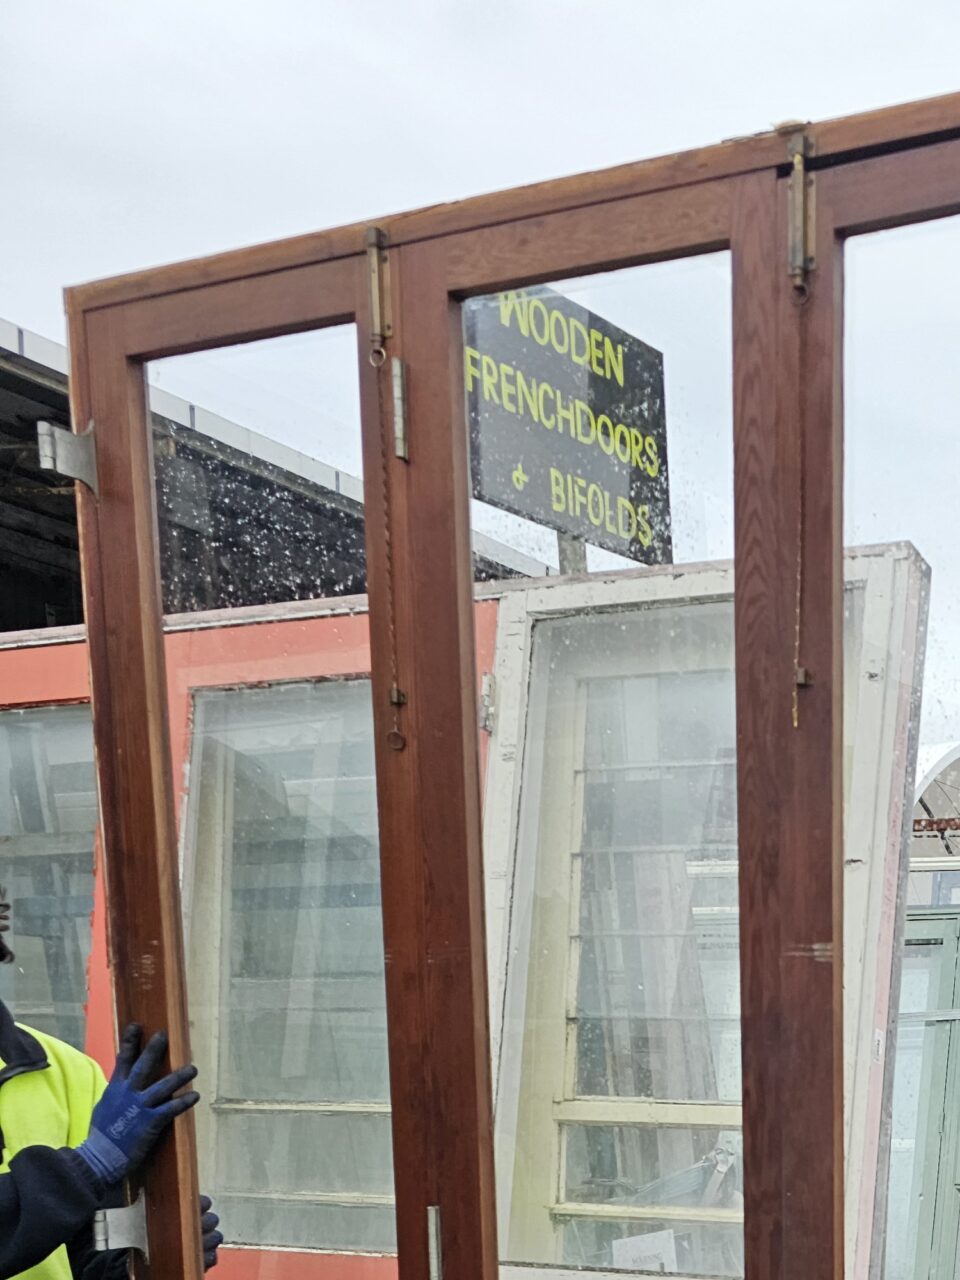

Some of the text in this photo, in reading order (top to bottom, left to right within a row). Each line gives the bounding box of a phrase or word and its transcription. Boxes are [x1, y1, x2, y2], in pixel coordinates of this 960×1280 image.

[500, 291, 625, 387] WOODEN
[512, 463, 653, 547] & BIFOLDS
